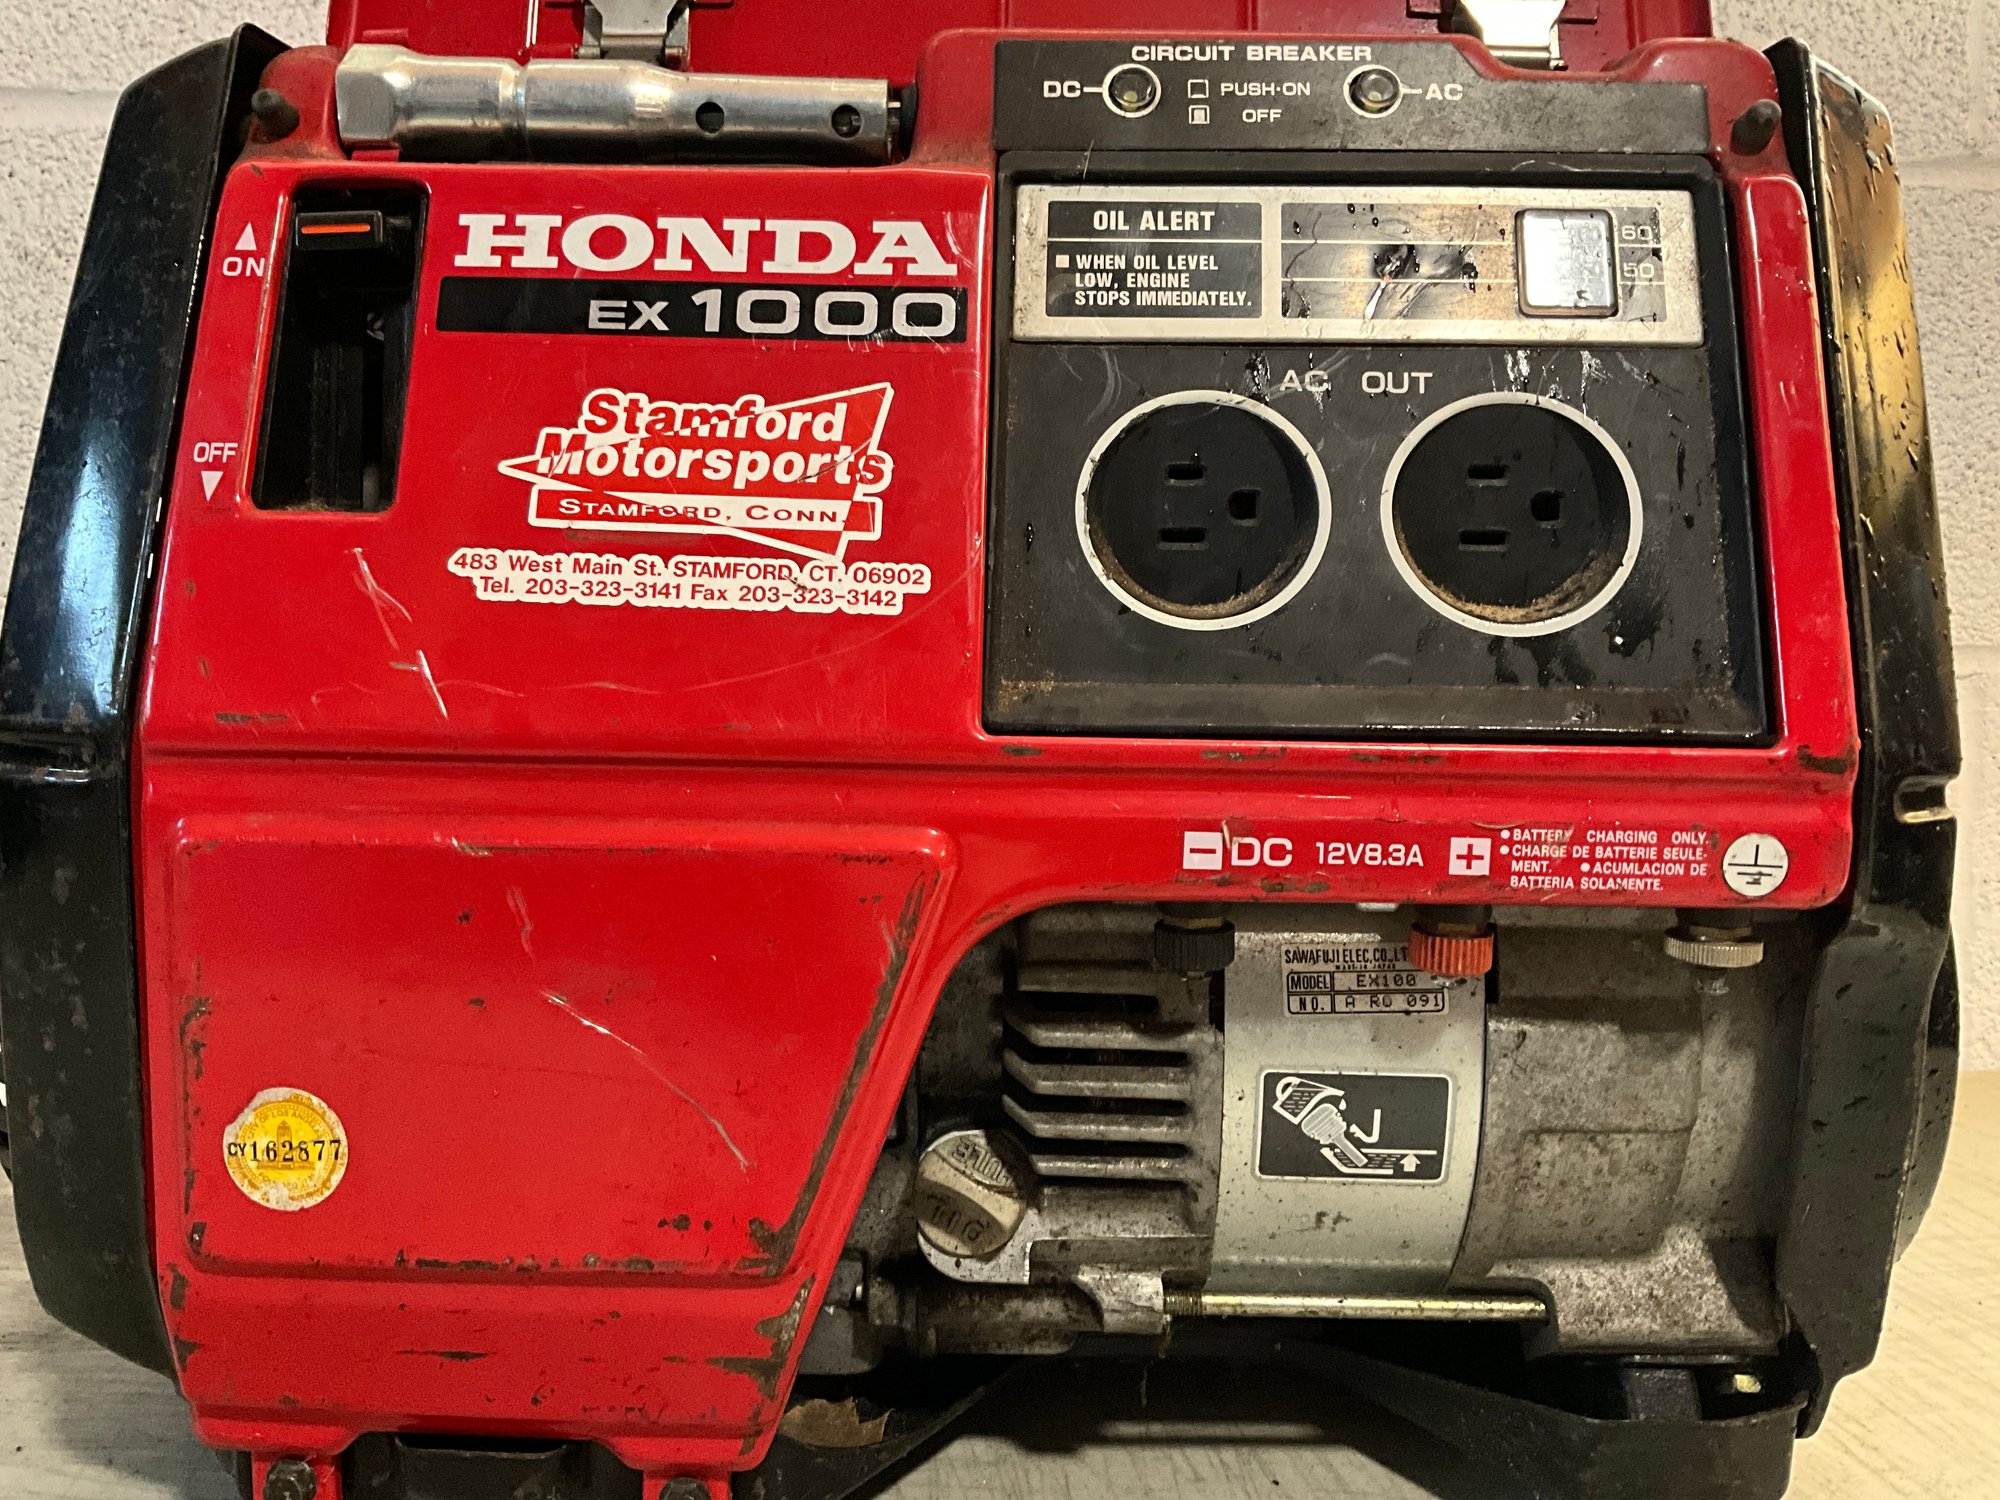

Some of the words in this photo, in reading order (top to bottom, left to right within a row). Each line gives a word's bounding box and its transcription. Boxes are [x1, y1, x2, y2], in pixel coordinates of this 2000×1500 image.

[1131, 45, 1235, 63] CIRCUIT
[1246, 45, 1373, 63] BREAKER
[1043, 80, 1082, 99] DC
[1425, 83, 1463, 101] AC
[1241, 109, 1282, 123] OFF
[1093, 210, 1130, 231] OIL
[1140, 210, 1216, 232] ALERT
[1621, 225, 1653, 241] 60
[453, 212, 958, 277] HONDA
[222, 256, 266, 278] ON
[1075, 254, 1126, 270] WHEN
[1133, 254, 1160, 270] OIL
[1167, 255, 1219, 271] LEVEL
[1623, 262, 1656, 279] 50
[1075, 272, 1119, 290] LOW,
[1126, 272, 1190, 289] ENGINE
[1074, 291, 1131, 306] STOPS
[1136, 291, 1252, 307] IMMEDIATELY.
[588, 299, 670, 333] EX
[690, 288, 957, 338] 1000
[1279, 369, 1329, 393] AC
[1361, 371, 1434, 394] OUT
[583, 393, 848, 442] Stamford
[192, 442, 239, 463] OFF
[536, 432, 889, 489] Motorsports
[453, 552, 498, 571] 483
[508, 555, 563, 574] West
[572, 557, 624, 576] Main
[632, 559, 662, 578] St.
[673, 560, 799, 581] STAMFORD,
[808, 564, 843, 583] CT.
[852, 566, 926, 586] 06902
[479, 576, 515, 594] Tel.
[524, 577, 682, 600] 203-323-3141
[690, 583, 729, 602] Fax
[738, 584, 898, 608] 203-323-3142
[1512, 829, 1572, 843] BATTERY
[1586, 829, 1659, 845] CHARGING
[1671, 831, 1710, 845] ONLY.
[1230, 836, 1293, 868] DC
[1315, 841, 1425, 868] 12V8.3A
[1511, 844, 1568, 859] CHARGE
[1572, 845, 1590, 859] DE
[1595, 846, 1658, 860] BATTERIE
[1662, 847, 1708, 860] SEULE-
[1511, 860, 1553, 874] MENT.
[1592, 861, 1685, 876] ACUMLACION
[1689, 862, 1708, 876] DE
[1509, 875, 1575, 889] BATTERIA
[1579, 876, 1664, 891] SOLAMENTE.
[1284, 948, 1340, 965] SAWAFUJI
[1290, 974, 1330, 990] MODEL
[1298, 996, 1325, 1012] NO.
[1345, 995, 1355, 1009] A
